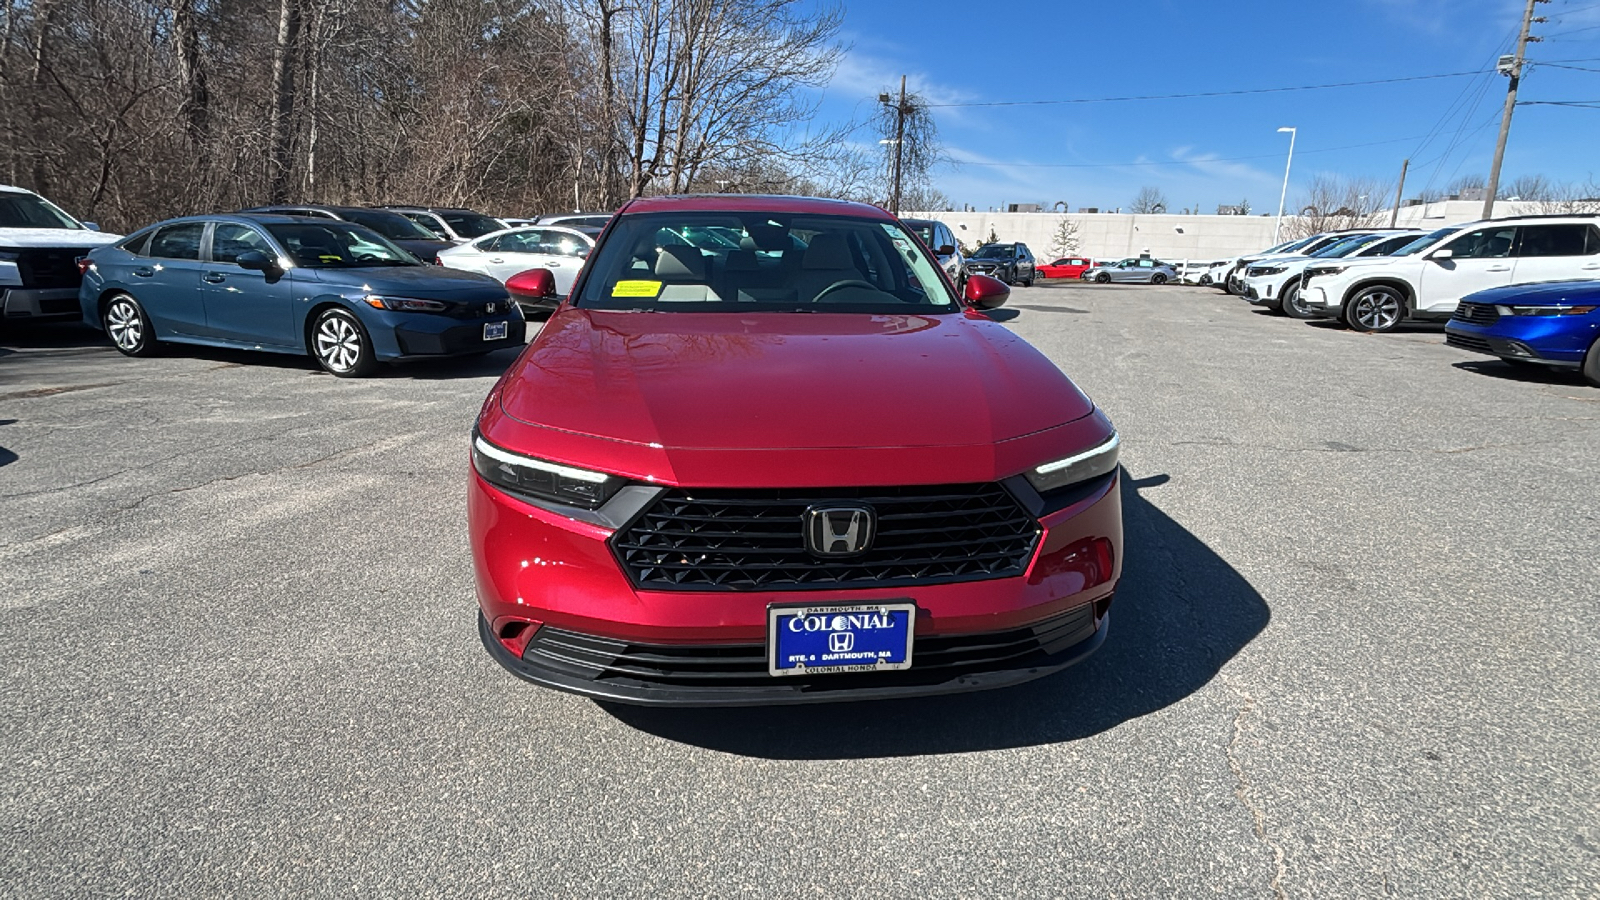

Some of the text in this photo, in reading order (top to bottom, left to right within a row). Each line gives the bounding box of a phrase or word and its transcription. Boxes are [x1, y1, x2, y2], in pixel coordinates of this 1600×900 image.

[788, 614, 895, 632] COLONIAL
[788, 654, 808, 662] RTE.
[821, 651, 877, 661] DARTMOUTH,
[804, 664, 877, 674] COLONIAL HONDA
